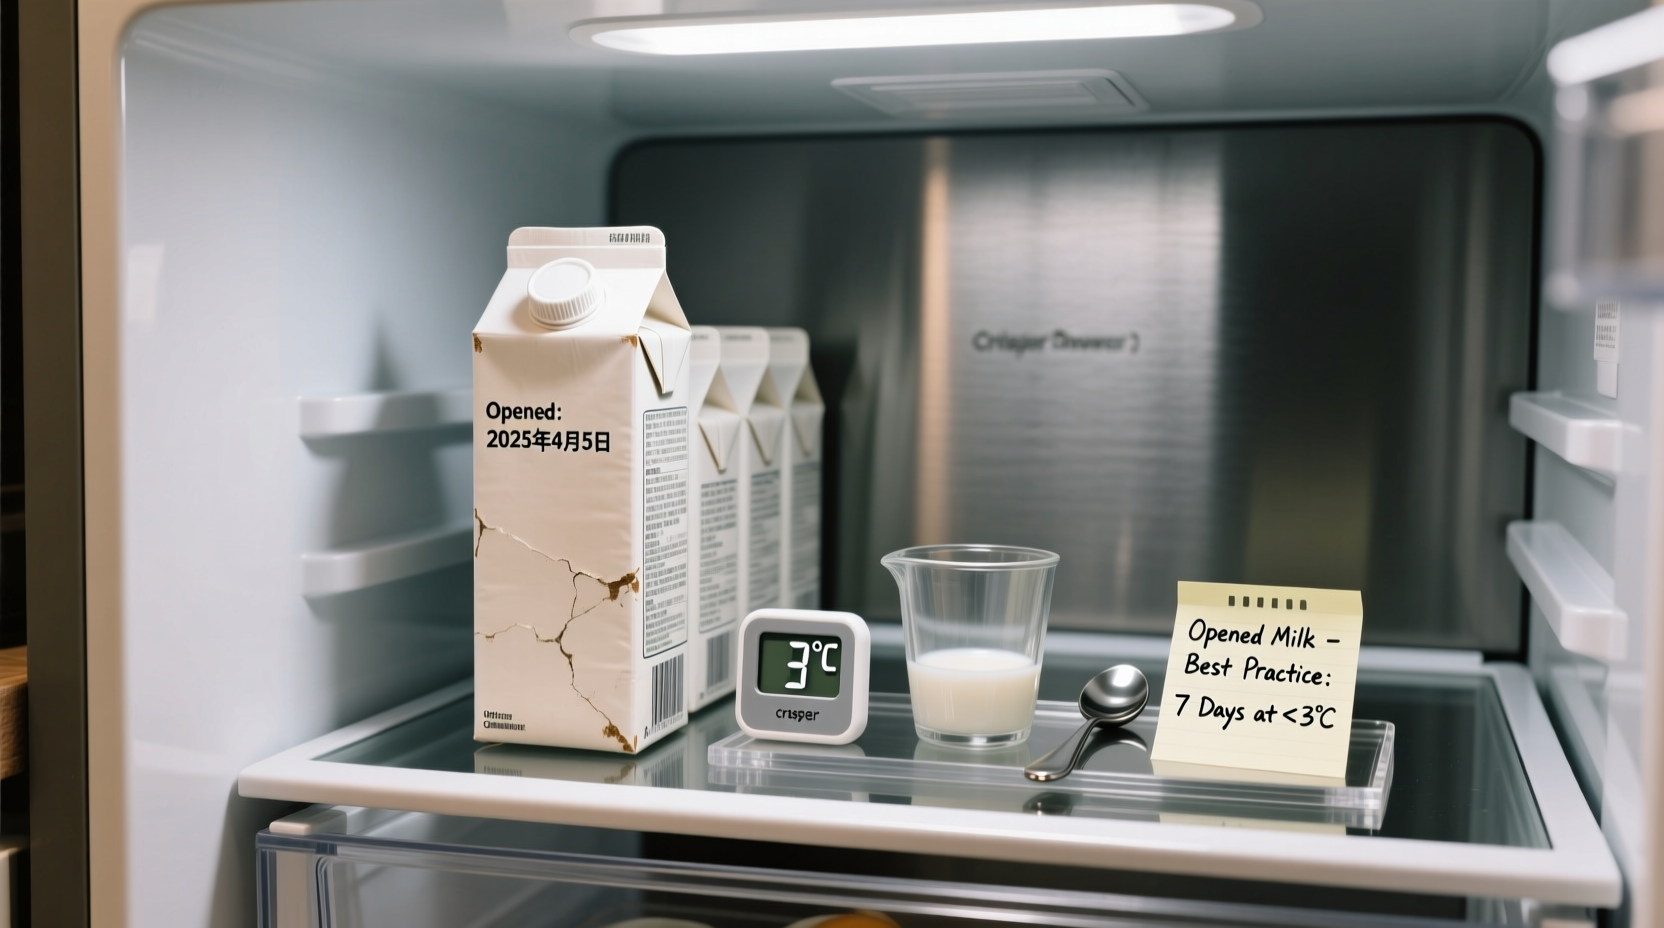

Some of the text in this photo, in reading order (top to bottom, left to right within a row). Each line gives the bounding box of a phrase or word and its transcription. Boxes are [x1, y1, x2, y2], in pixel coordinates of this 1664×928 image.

[485, 401, 562, 424] Opened:
[486, 428, 610, 452] 2025年4月5日
[1188, 618, 1265, 649] Opened
[1271, 625, 1315, 648] Milk
[785, 640, 839, 690] 3°C
[1184, 652, 1331, 686] Best Practice:
[1175, 693, 1190, 717] 7
[1198, 696, 1245, 730] Days
[1253, 704, 1278, 724] at
